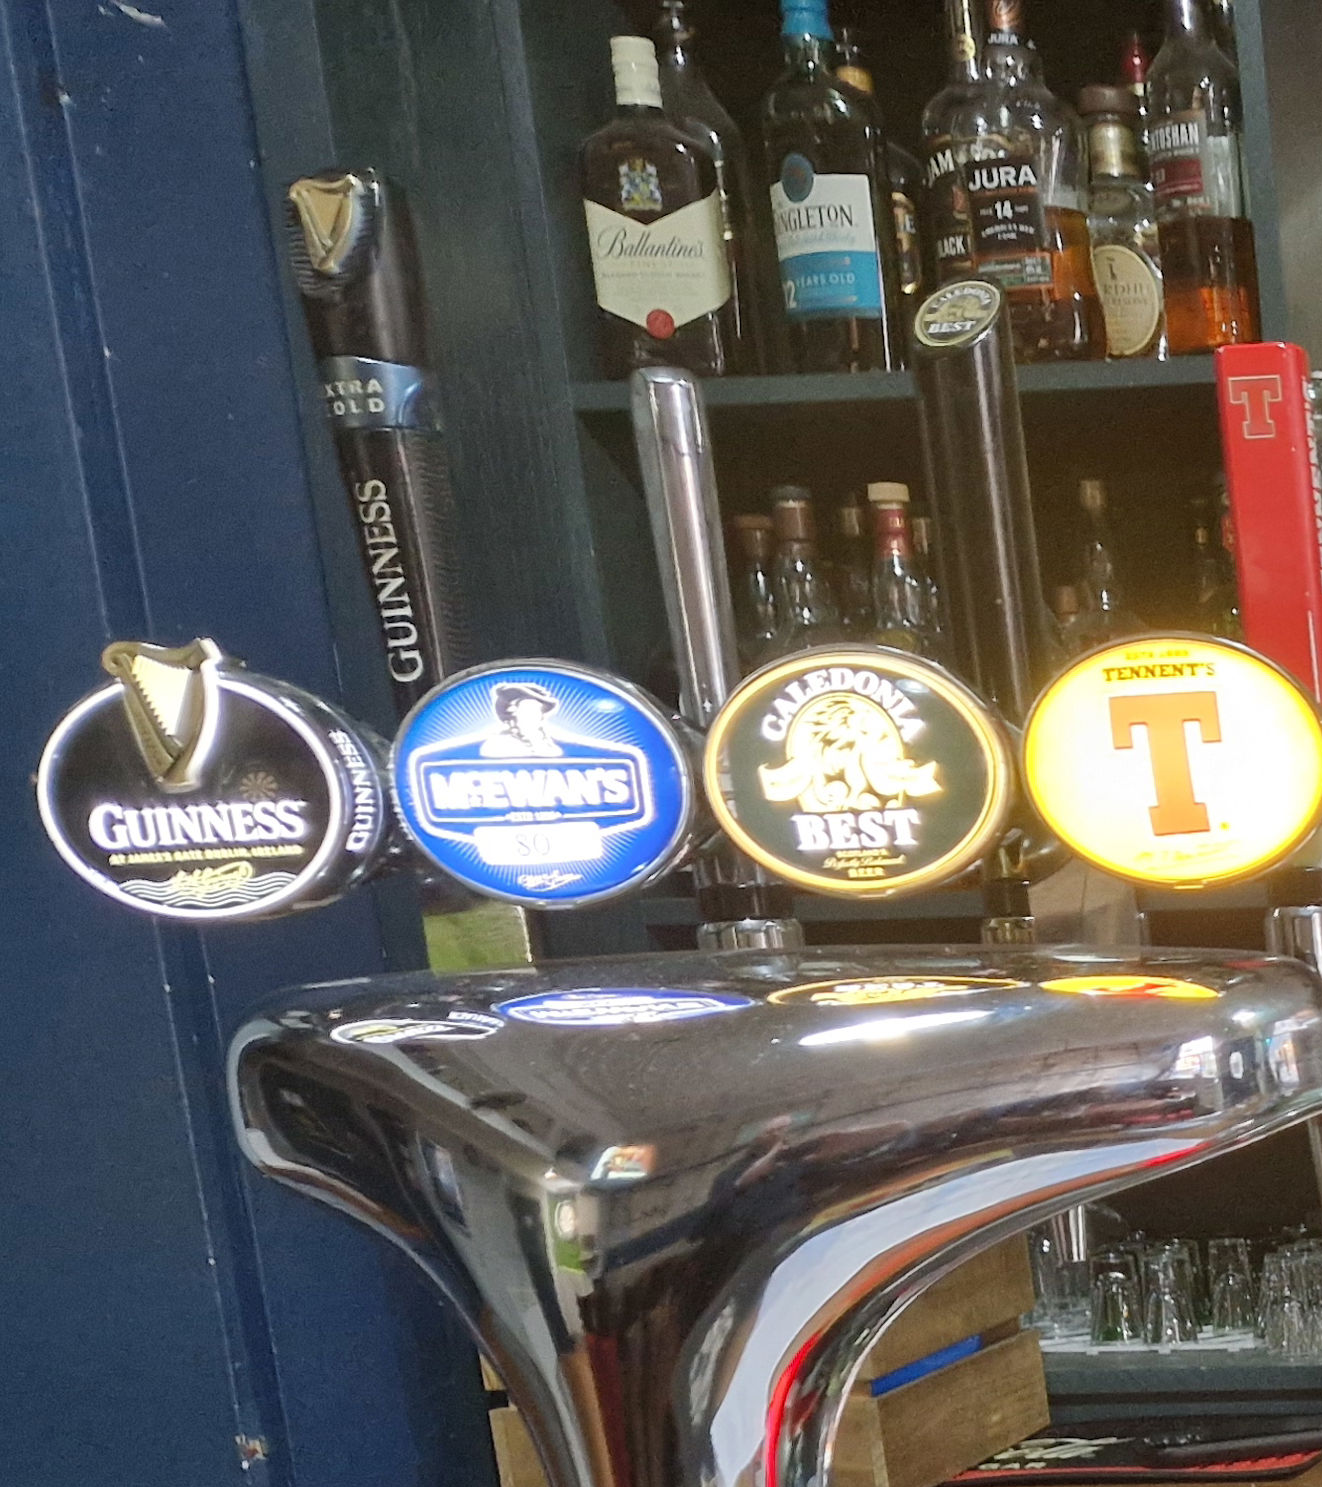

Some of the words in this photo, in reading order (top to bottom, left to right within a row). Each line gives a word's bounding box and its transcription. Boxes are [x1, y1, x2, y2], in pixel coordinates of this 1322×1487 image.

[968, 165, 1037, 192] JURA
[773, 203, 853, 233] NGLETON
[995, 200, 1012, 219] 14
[597, 228, 704, 258] Ballantine's
[830, 272, 855, 285] OLD
[324, 378, 383, 398] XTRA
[327, 397, 386, 417] OLD
[1228, 374, 1282, 439] T
[356, 479, 424, 683] GUINNESS
[1102, 662, 1217, 683] TENNENT'S
[761, 666, 926, 743] CALEDONIA
[1109, 690, 1222, 836] T
[329, 729, 375, 853] GUINNESS
[88, 799, 308, 851] GUINNESS
[790, 808, 922, 852] BEST
